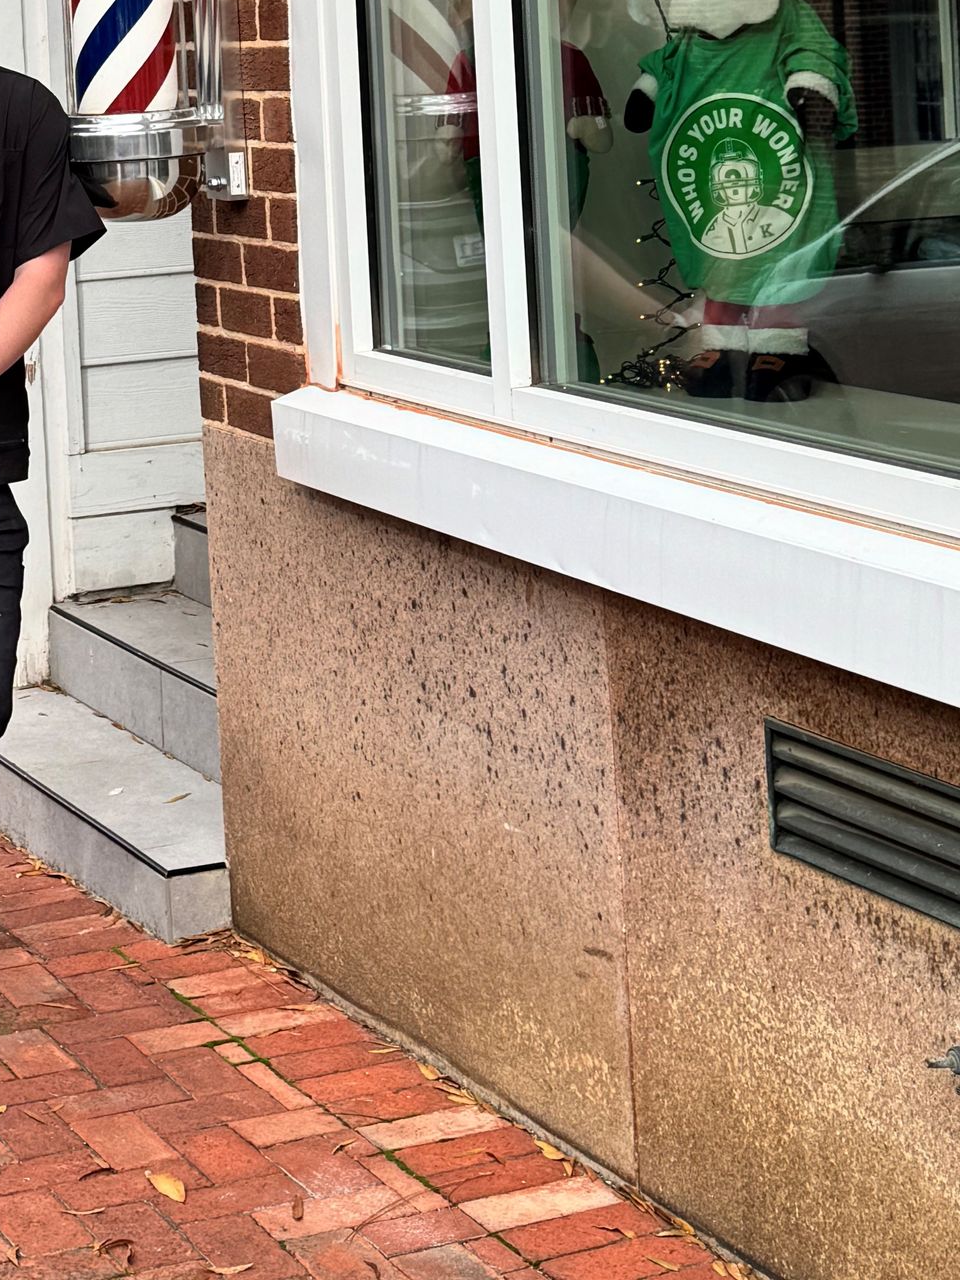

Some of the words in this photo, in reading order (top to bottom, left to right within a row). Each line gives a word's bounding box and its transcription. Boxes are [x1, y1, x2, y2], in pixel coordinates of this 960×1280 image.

[687, 108, 744, 143] YOUR
[677, 144, 705, 224] WHO'S
[751, 114, 801, 210] WONDER
[759, 223, 775, 238] K
